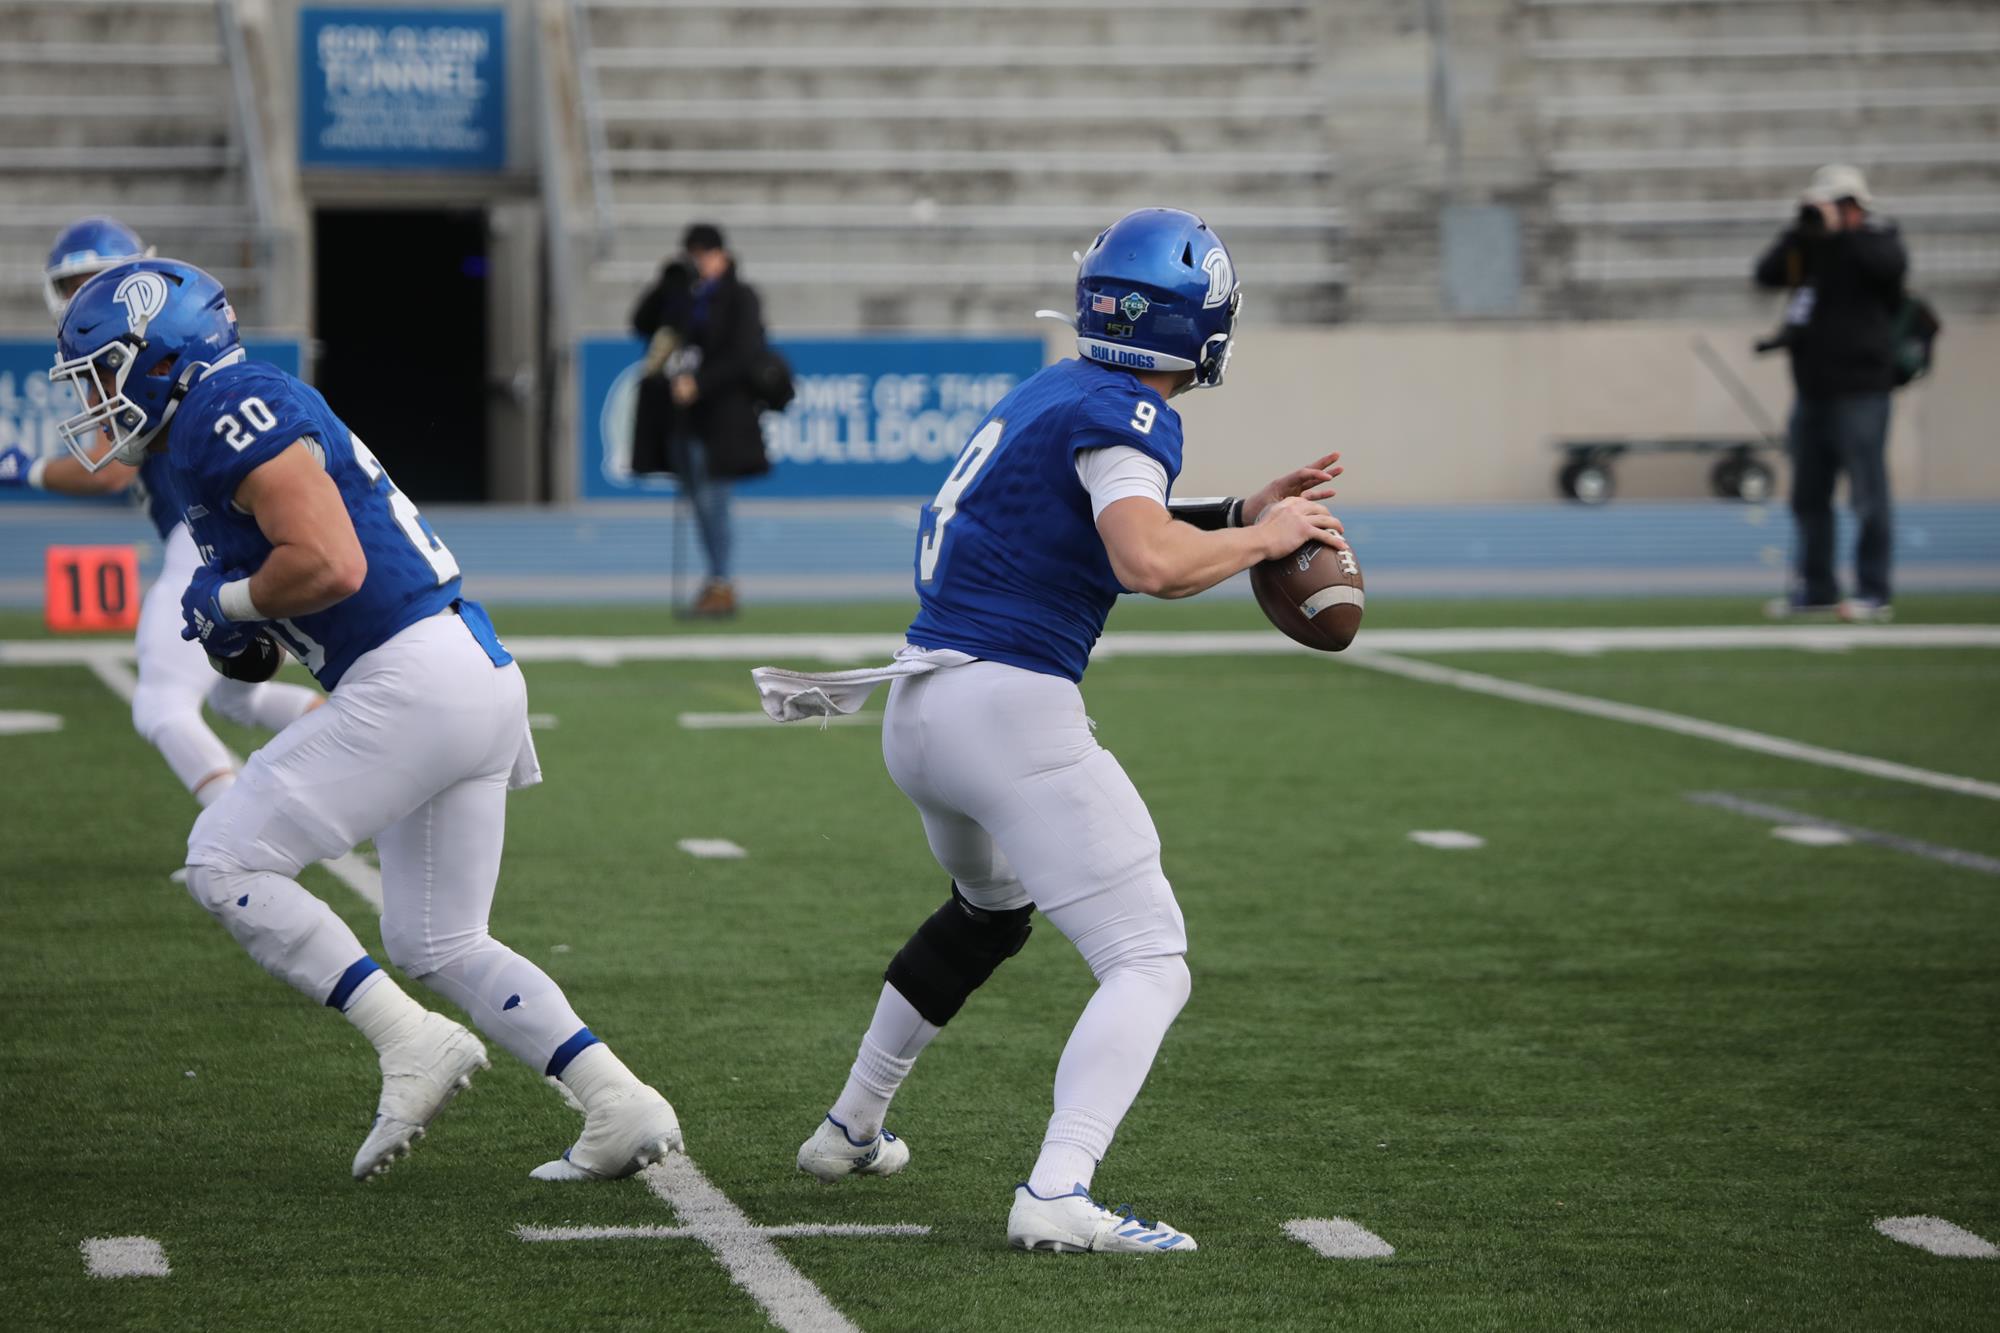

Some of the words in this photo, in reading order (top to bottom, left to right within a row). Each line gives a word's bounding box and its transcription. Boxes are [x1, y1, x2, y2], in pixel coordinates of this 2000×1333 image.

[323, 56, 488, 95] TUNNEL
[1091, 344, 1156, 369] BULLDOGS
[874, 375, 930, 413] OF
[213, 397, 277, 453] 20
[1131, 401, 1157, 434] 9
[919, 417, 1004, 582] 9
[65, 561, 126, 617] 10
